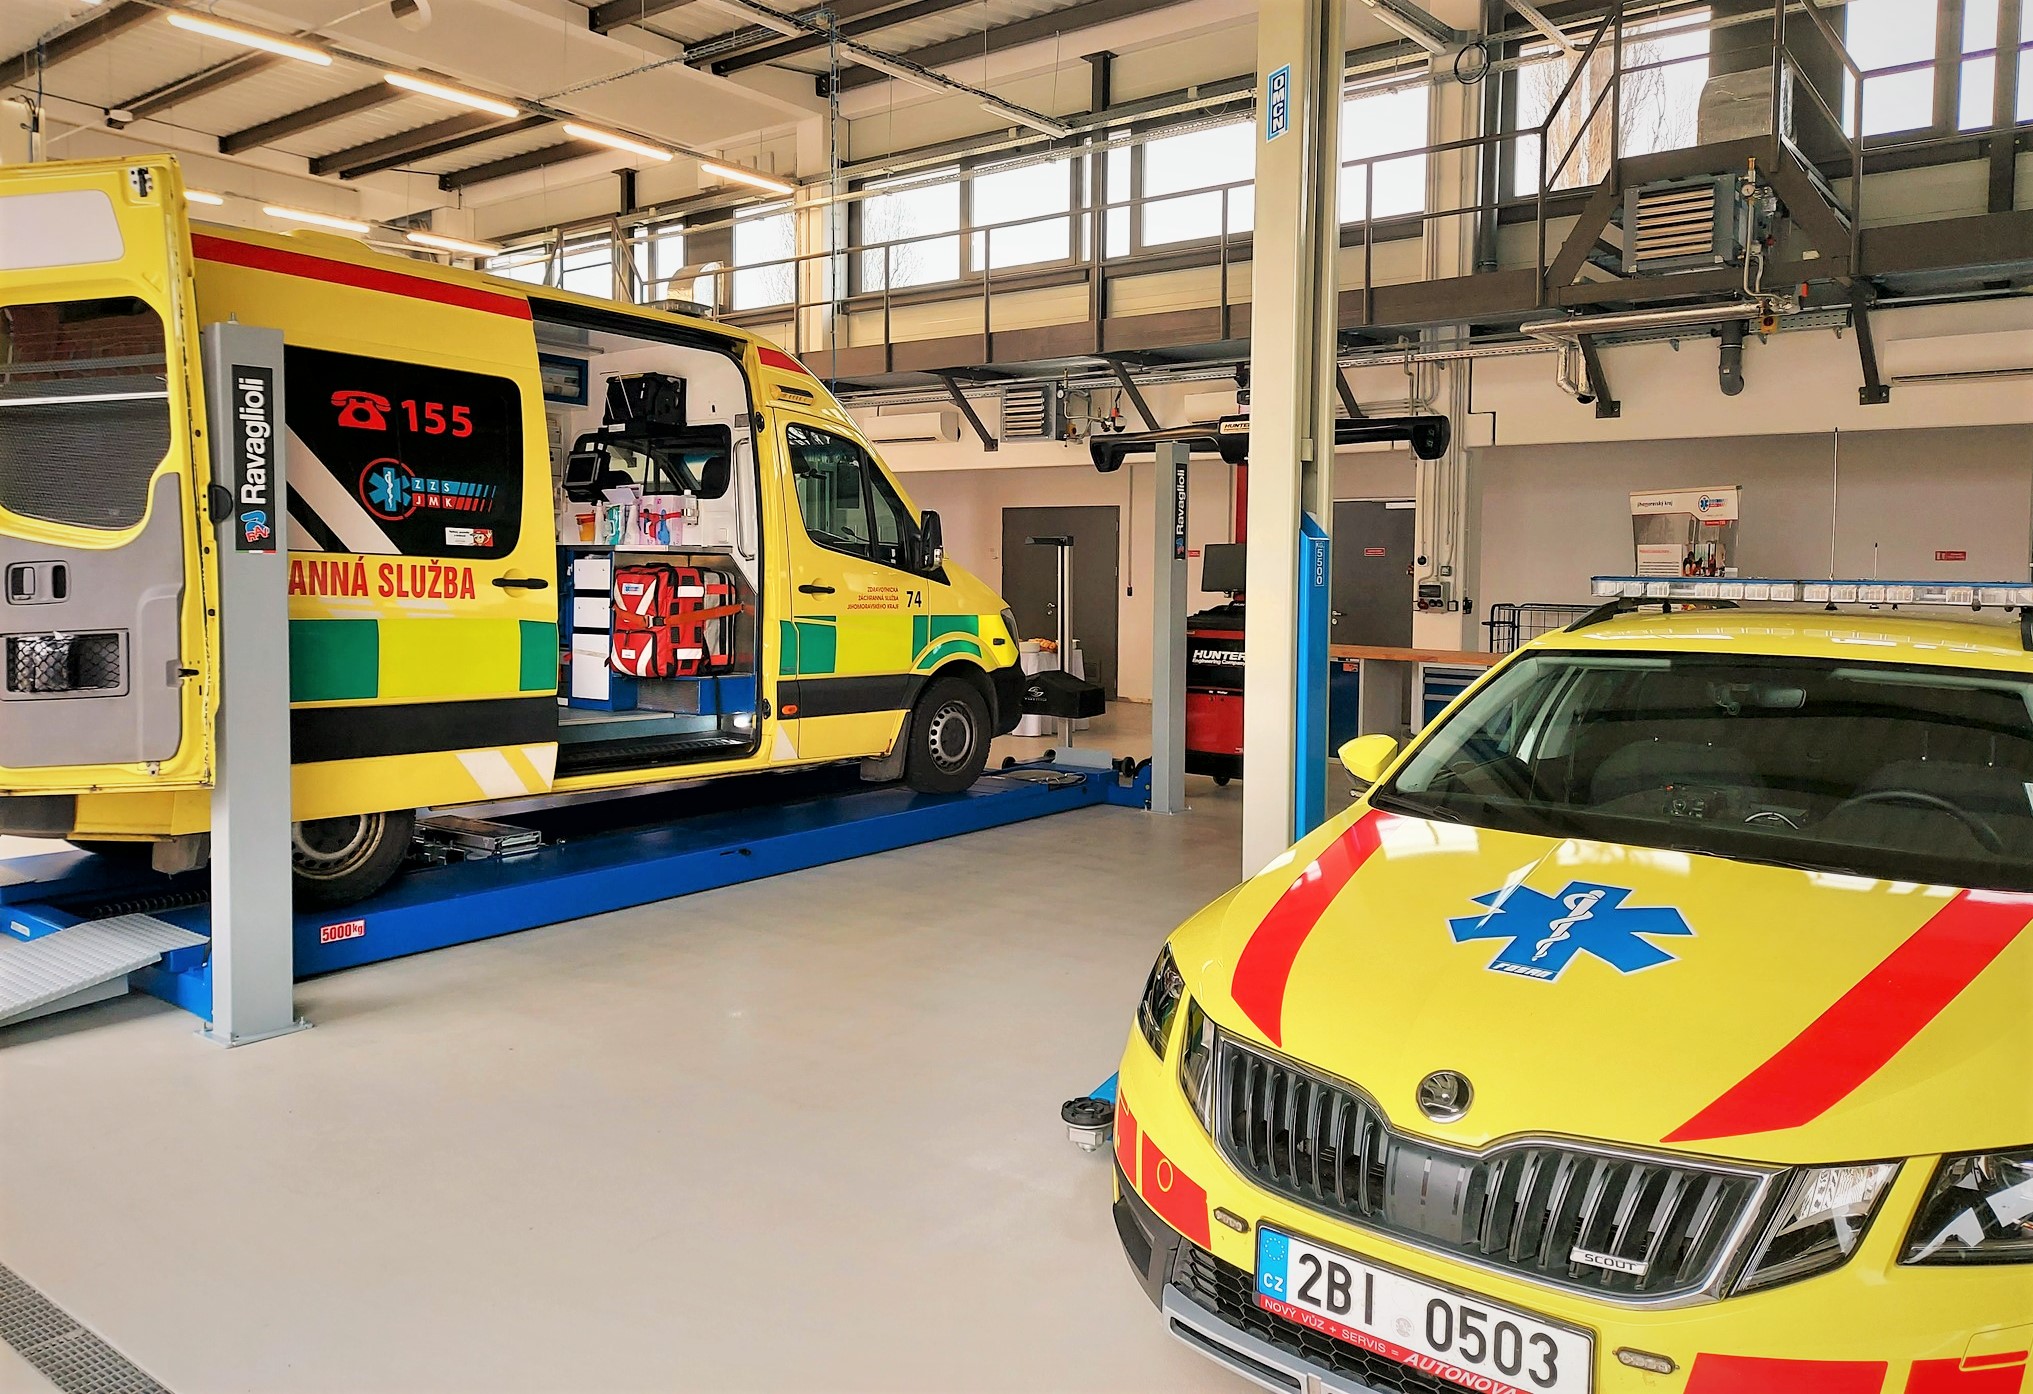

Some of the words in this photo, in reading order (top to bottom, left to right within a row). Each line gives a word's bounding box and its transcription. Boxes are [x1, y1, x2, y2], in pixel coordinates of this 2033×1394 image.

[1272, 74, 1285, 133] OMCN
[238, 377, 271, 504] Ravaglioli
[401, 399, 473, 437] 155
[1176, 469, 1186, 535] Ravaglioli
[378, 559, 476, 600] SLUŽBA
[906, 590, 922, 608] 74
[1263, 1272, 1284, 1293] CZ
[1584, 1253, 1637, 1271] SCOUT
[1264, 1298, 1297, 1318] NOVÝ
[1301, 1312, 1325, 1330] VŮZ
[1341, 1329, 1386, 1353] SERVIS
[1297, 1253, 1374, 1326] 2BI
[1425, 1298, 1559, 1389] 0503
